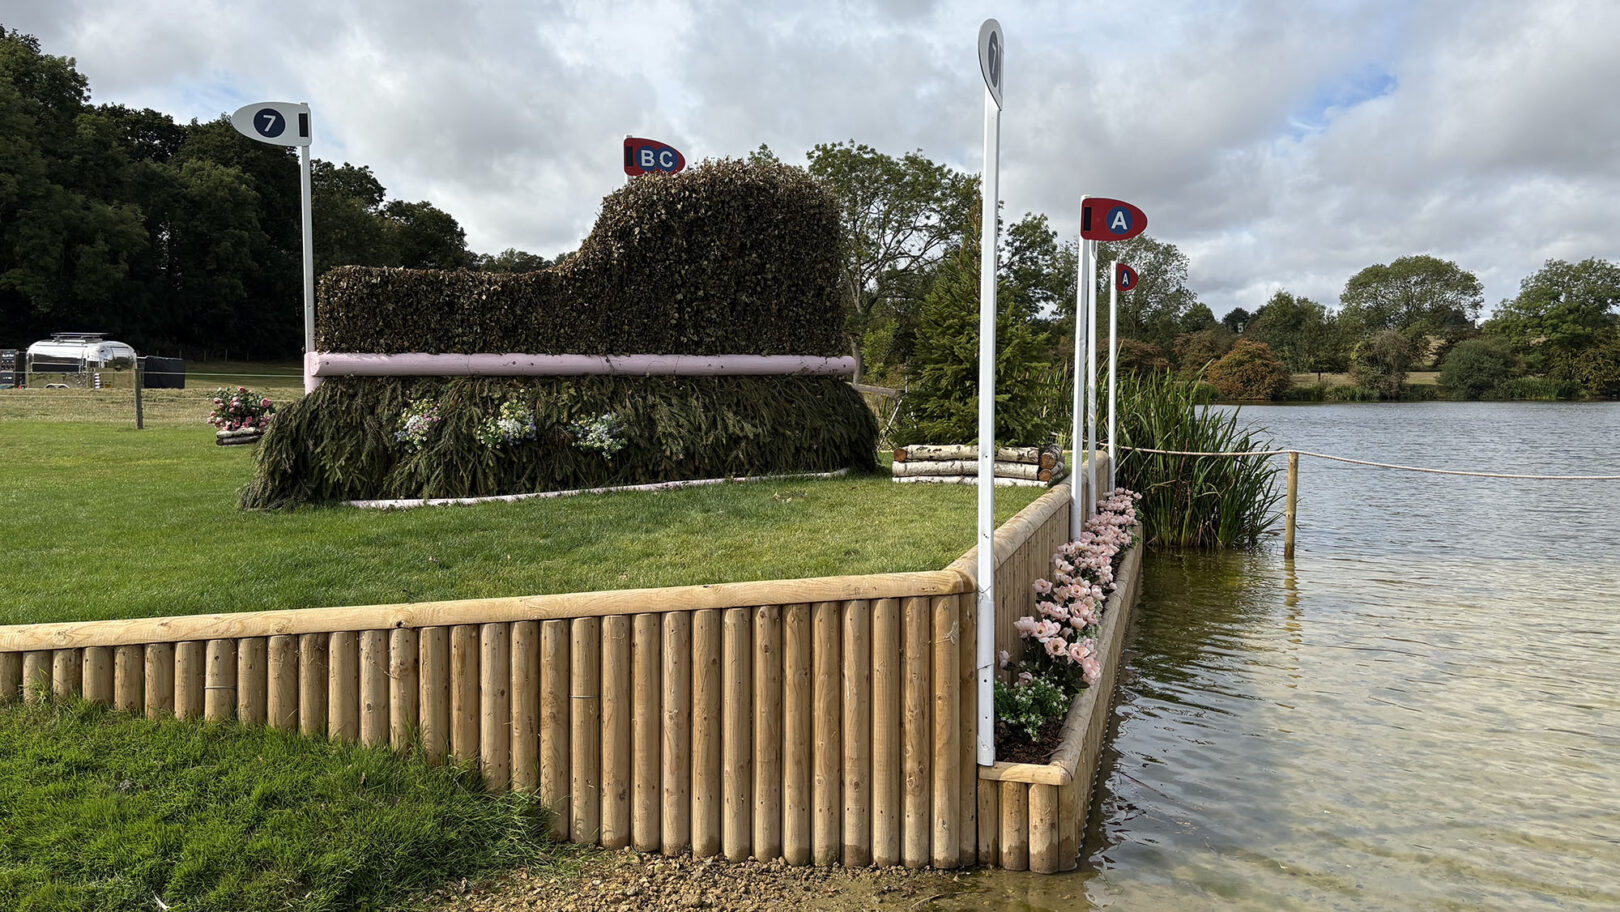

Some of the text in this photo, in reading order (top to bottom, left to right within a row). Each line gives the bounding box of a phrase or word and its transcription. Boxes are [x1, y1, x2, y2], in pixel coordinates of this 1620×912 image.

[263, 114, 277, 132] 7
[640, 149, 674, 168] BC
[1111, 210, 1128, 230] A
[1122, 272, 1129, 285] A
